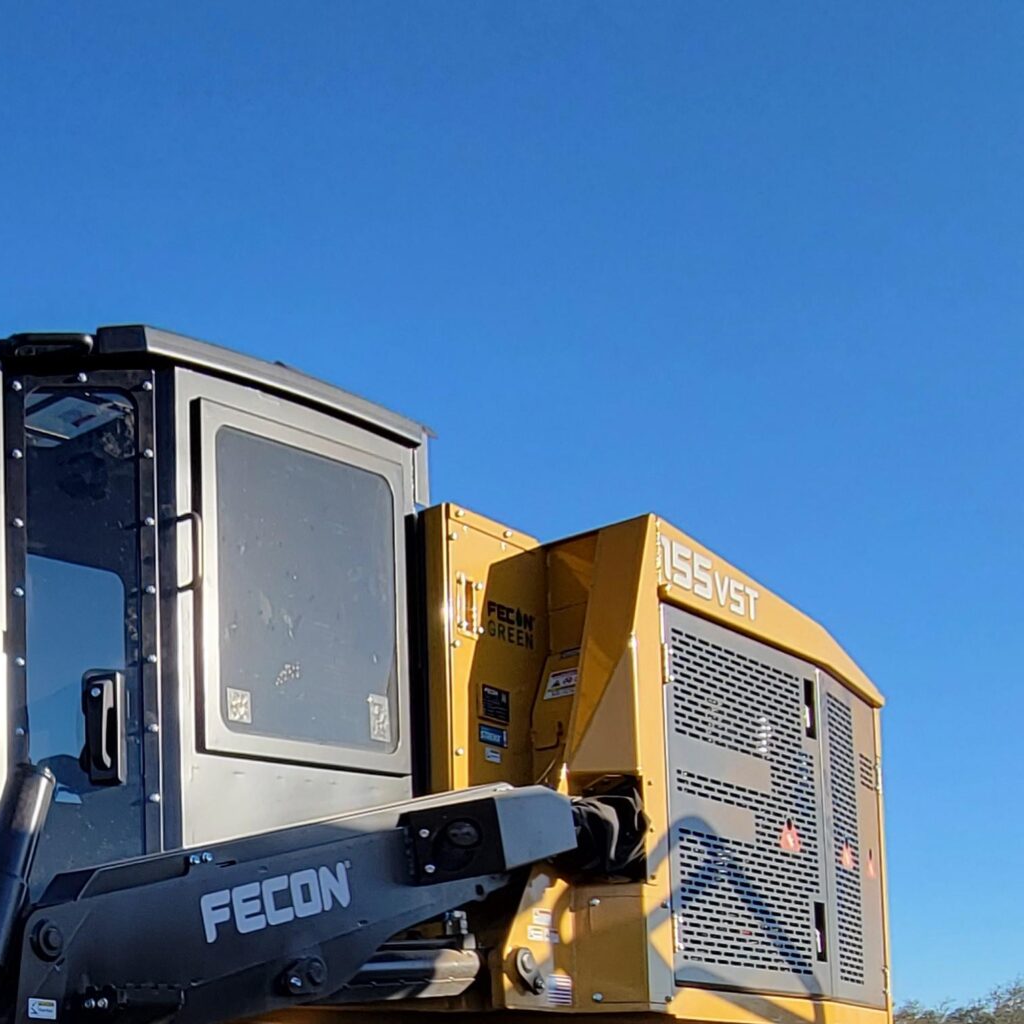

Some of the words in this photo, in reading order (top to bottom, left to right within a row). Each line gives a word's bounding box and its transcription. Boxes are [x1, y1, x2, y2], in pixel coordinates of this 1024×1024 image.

[659, 534, 713, 601] 155
[714, 571, 759, 621] VST
[487, 620, 534, 650] GREEN
[201, 862, 351, 943] FECON
